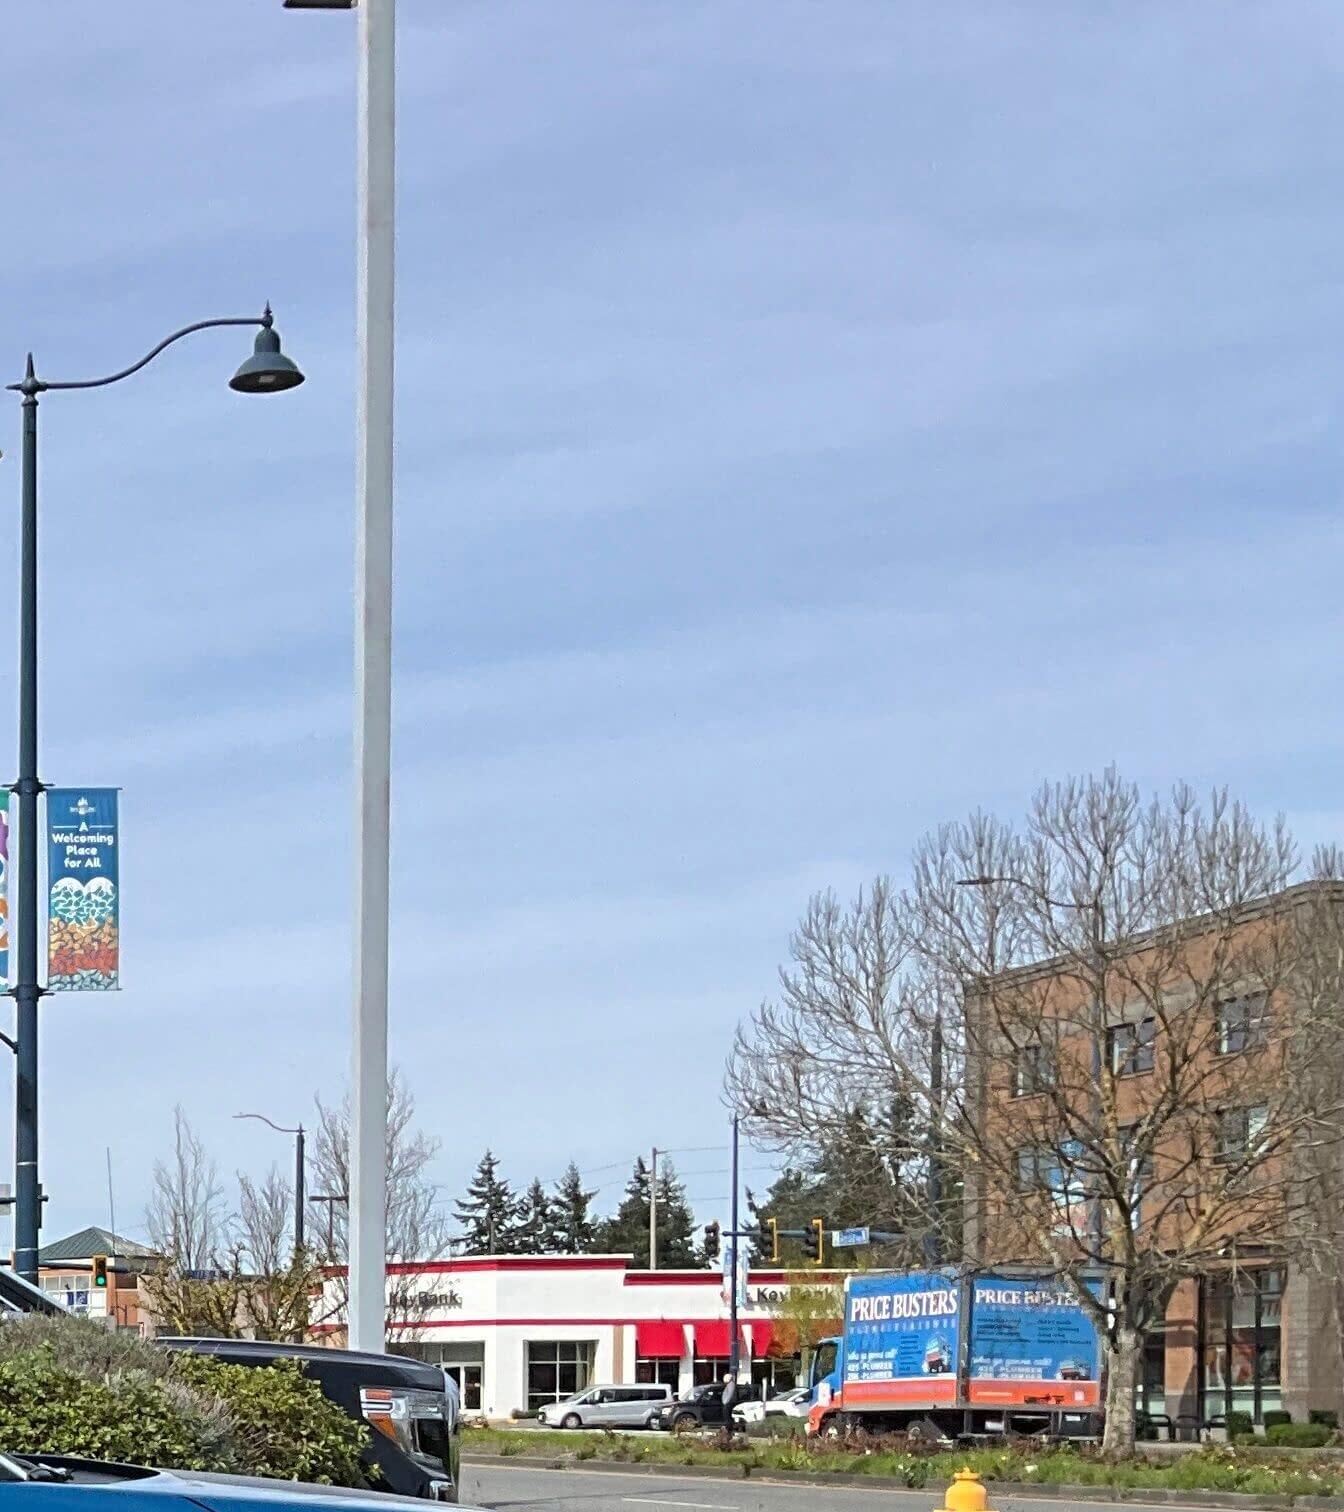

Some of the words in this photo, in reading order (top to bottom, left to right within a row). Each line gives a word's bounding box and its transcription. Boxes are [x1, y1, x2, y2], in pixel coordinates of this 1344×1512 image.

[79, 822, 89, 832] A
[52, 832, 114, 846] Welcoming
[66, 845, 98, 856] Place
[64, 858, 82, 868] for
[84, 857, 101, 868] All
[975, 1289, 1021, 1305] PRICE
[851, 1296, 892, 1322] PRICE
[892, 1289, 958, 1319] BUSTERS
